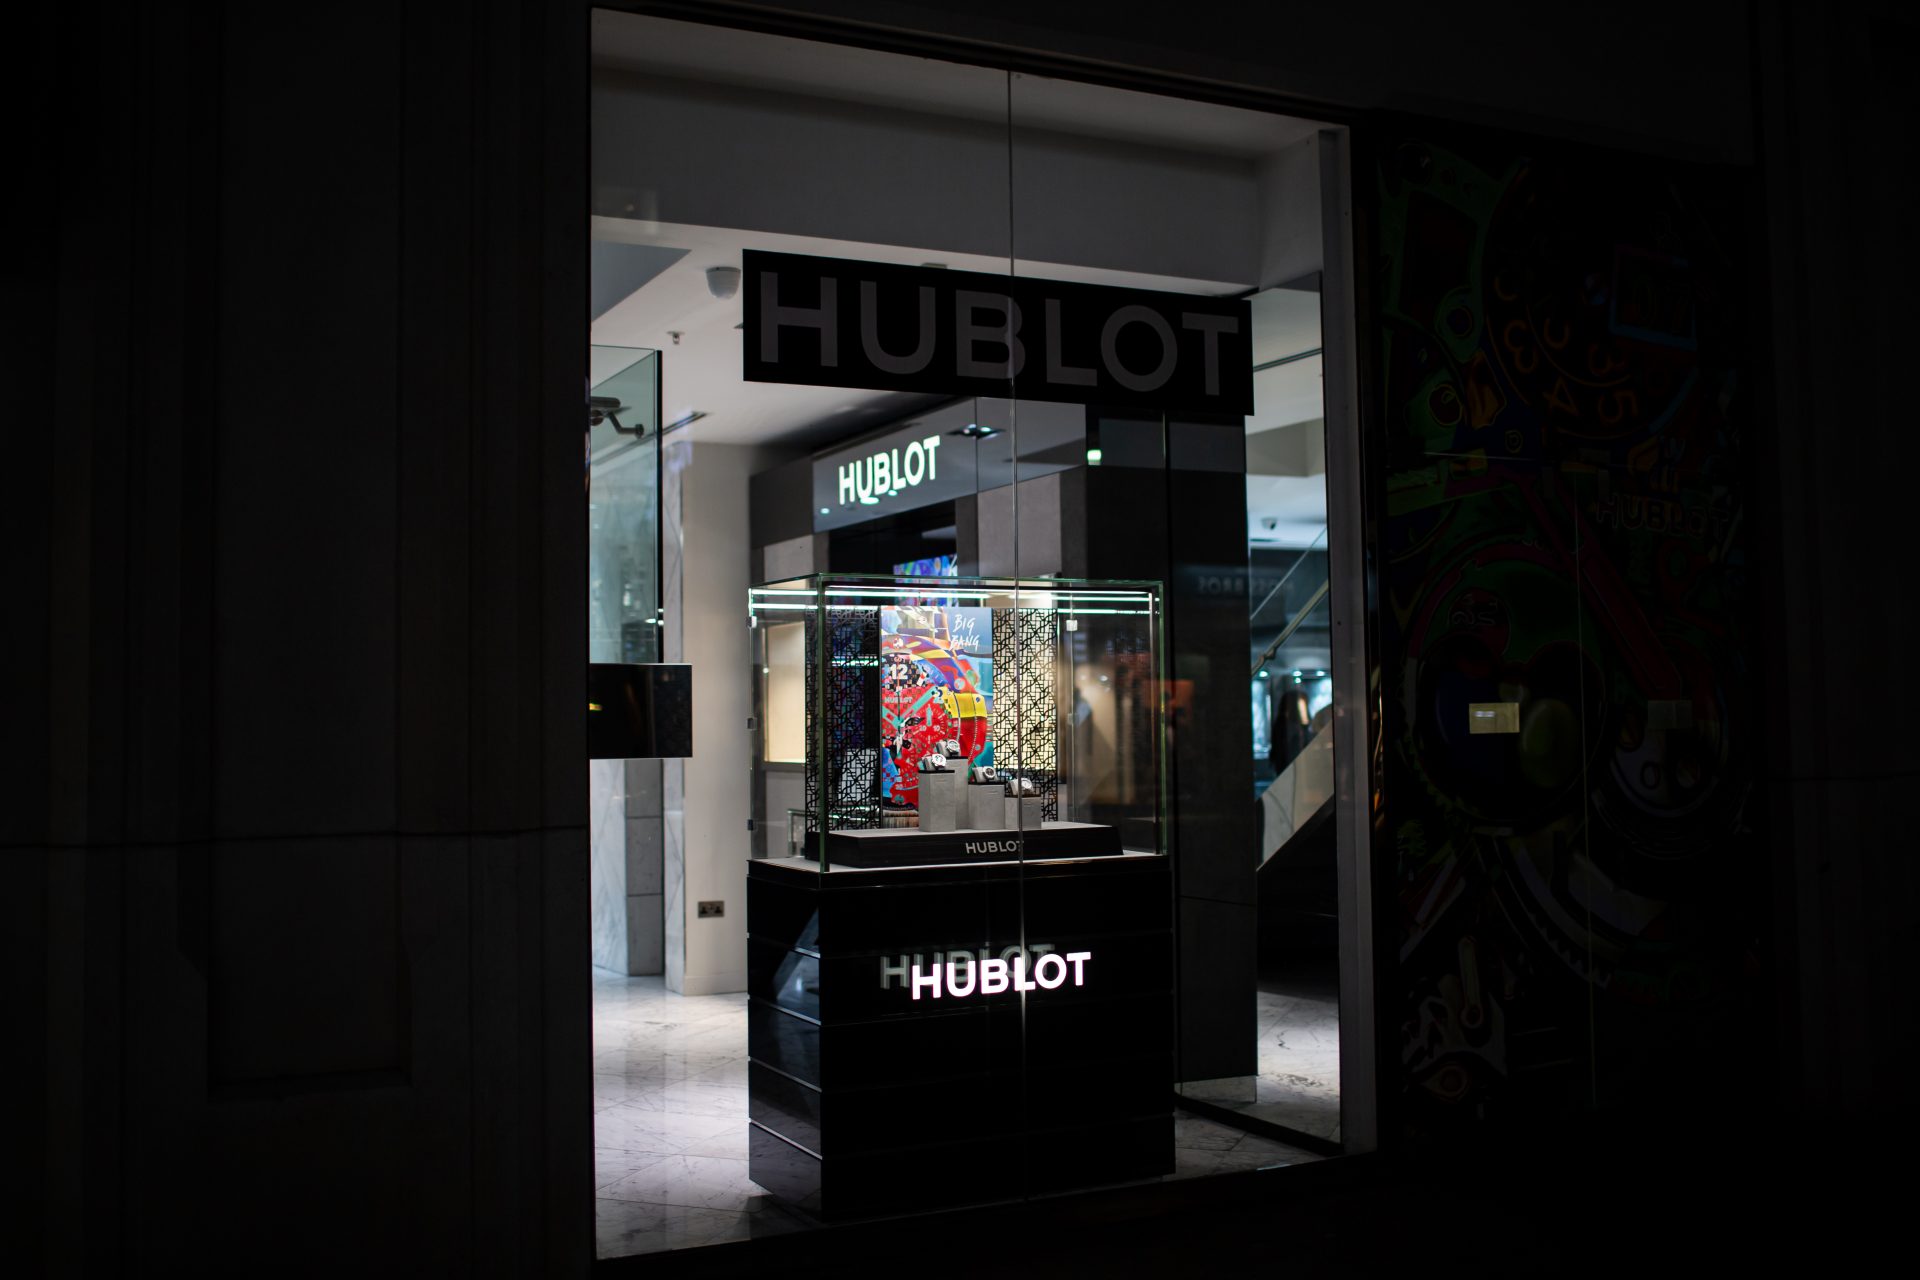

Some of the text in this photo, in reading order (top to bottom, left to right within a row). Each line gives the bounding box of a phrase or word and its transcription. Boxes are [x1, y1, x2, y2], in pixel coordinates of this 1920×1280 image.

[759, 269, 1240, 398] HUBLOT
[838, 435, 941, 505] HUBLOT
[952, 614, 976, 636] BIG
[890, 664, 909, 680] 12
[911, 951, 1092, 1000] HUBLOT
